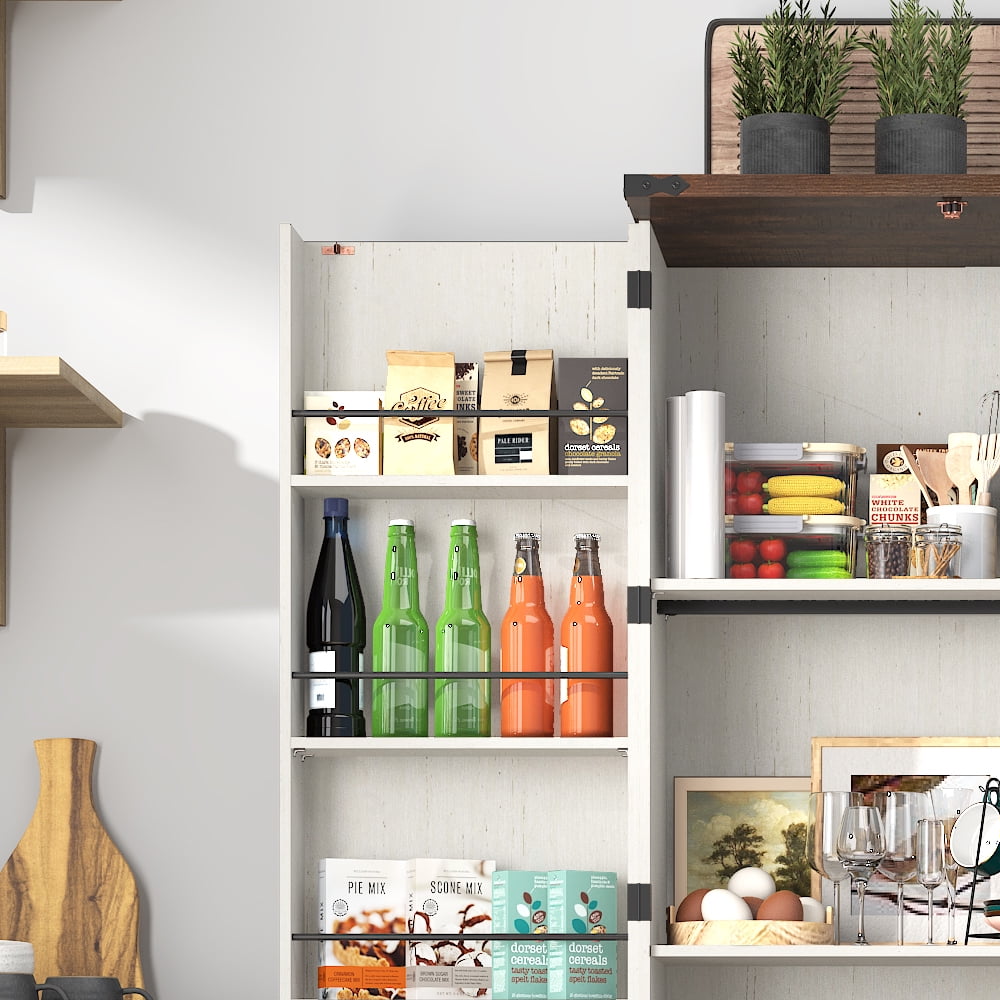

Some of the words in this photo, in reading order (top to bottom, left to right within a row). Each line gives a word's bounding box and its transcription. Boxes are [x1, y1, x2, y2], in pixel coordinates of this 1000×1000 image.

[512, 436, 529, 444] RIDER
[564, 443, 590, 451] dorset
[591, 443, 621, 451] cereals
[871, 513, 919, 521] CHUNKS
[348, 881, 363, 895] PIE
[368, 881, 386, 895] MIX
[430, 880, 461, 894] SCONE
[466, 882, 483, 895] MIX
[511, 942, 548, 953] dorset
[568, 942, 604, 953] dorset
[568, 955, 608, 966] cereals
[511, 967, 530, 975] tasty
[569, 967, 586, 975] tasty
